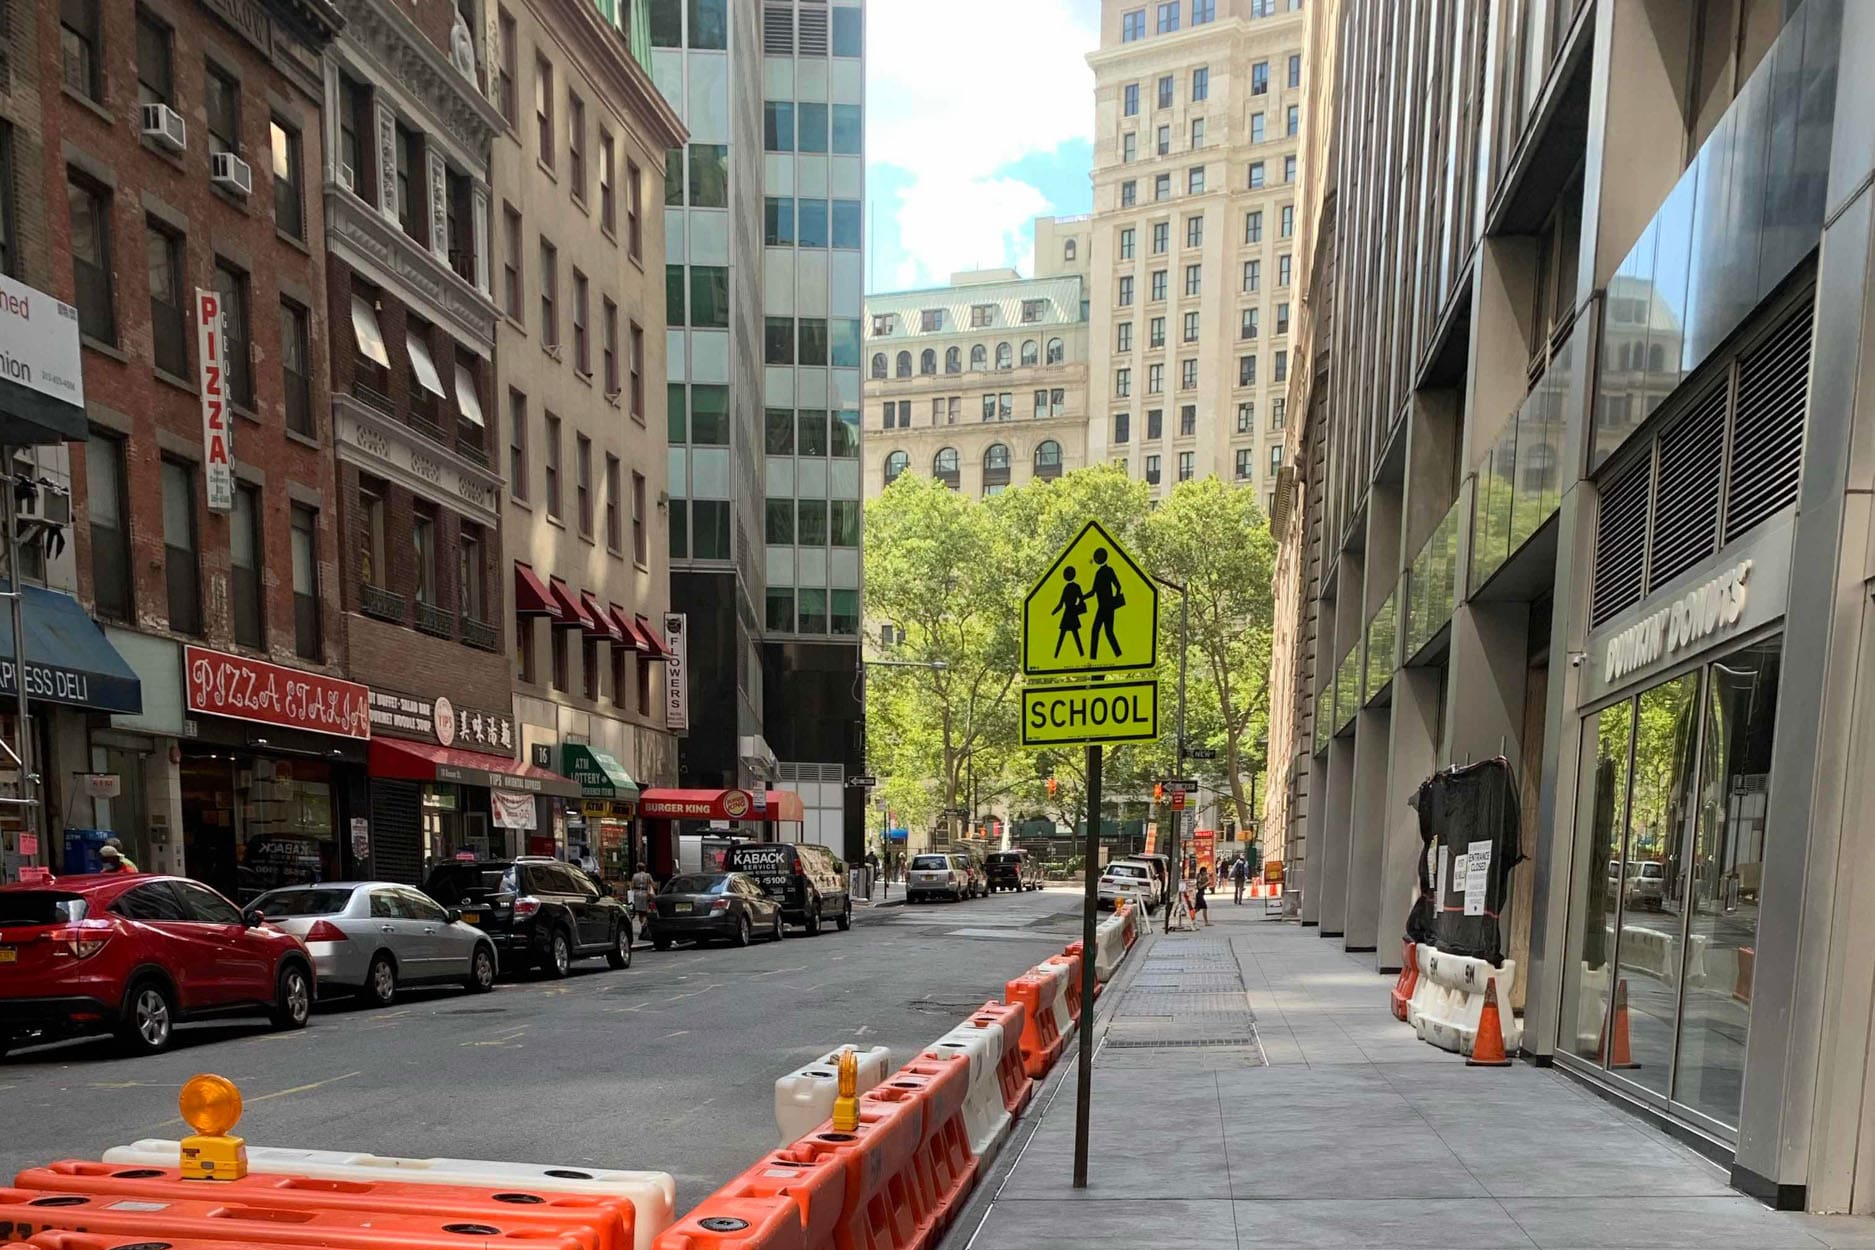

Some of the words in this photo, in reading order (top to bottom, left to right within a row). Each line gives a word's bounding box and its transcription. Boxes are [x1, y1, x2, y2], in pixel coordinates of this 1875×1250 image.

[201, 295, 227, 464] PIZZA
[221, 311, 236, 494] GEORGIOS
[55, 670, 89, 701] DELI
[192, 659, 280, 712] PIZZA
[669, 637, 681, 709] FLOWERS
[1030, 694, 1150, 729] SCHOOL
[539, 747, 548, 764] 16
[645, 802, 684, 813] BURGER
[685, 804, 711, 814] KING
[733, 852, 785, 865] KABACK
